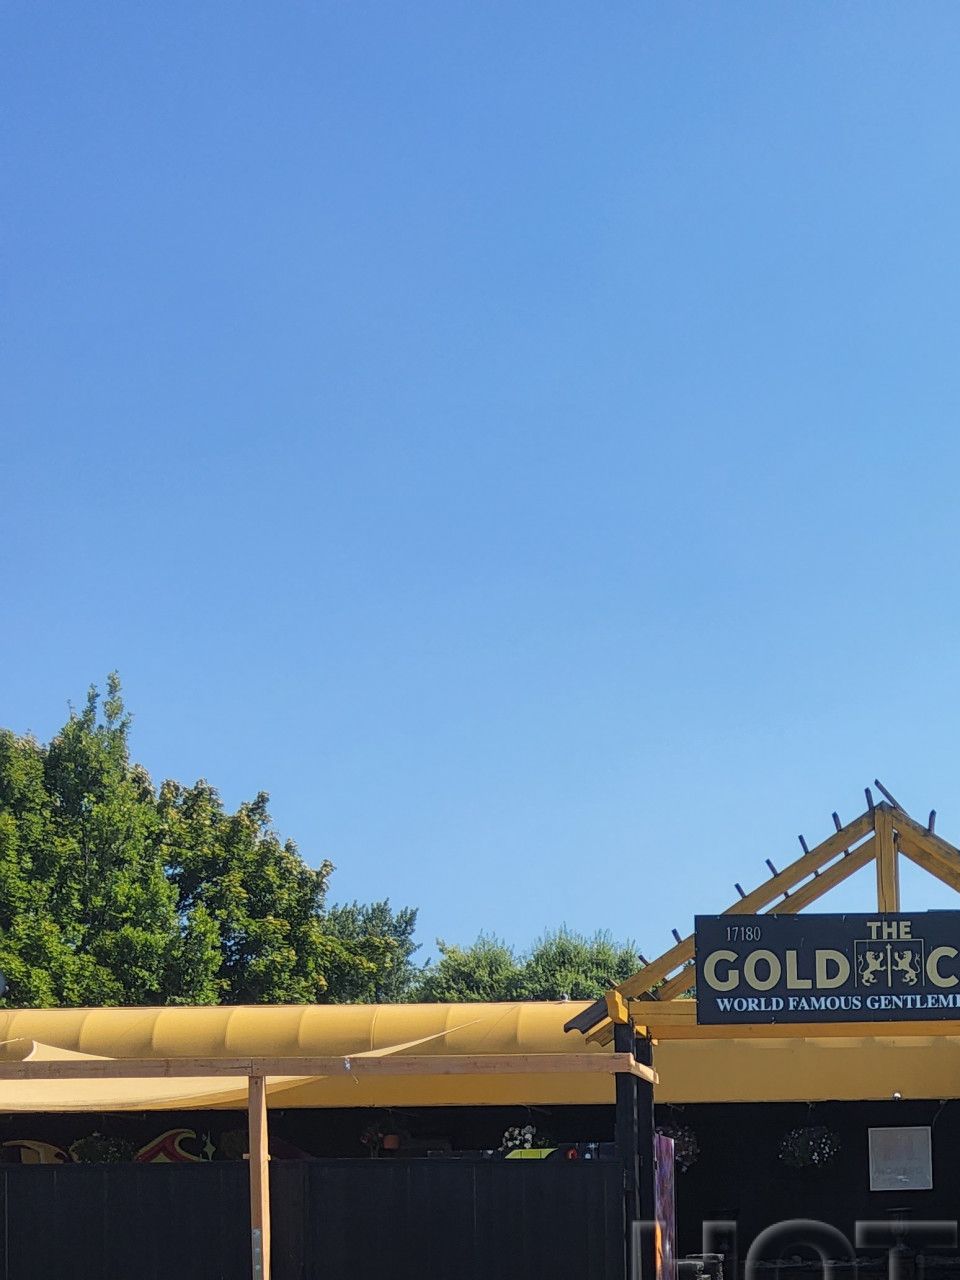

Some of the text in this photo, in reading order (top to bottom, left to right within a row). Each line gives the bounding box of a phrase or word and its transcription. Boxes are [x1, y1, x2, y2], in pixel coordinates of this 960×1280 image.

[726, 926, 761, 942] 17180
[866, 921, 912, 940] THE
[703, 949, 850, 992] GOLD
[716, 996, 784, 1011] WORLD
[788, 995, 862, 1011] FAMOUS
